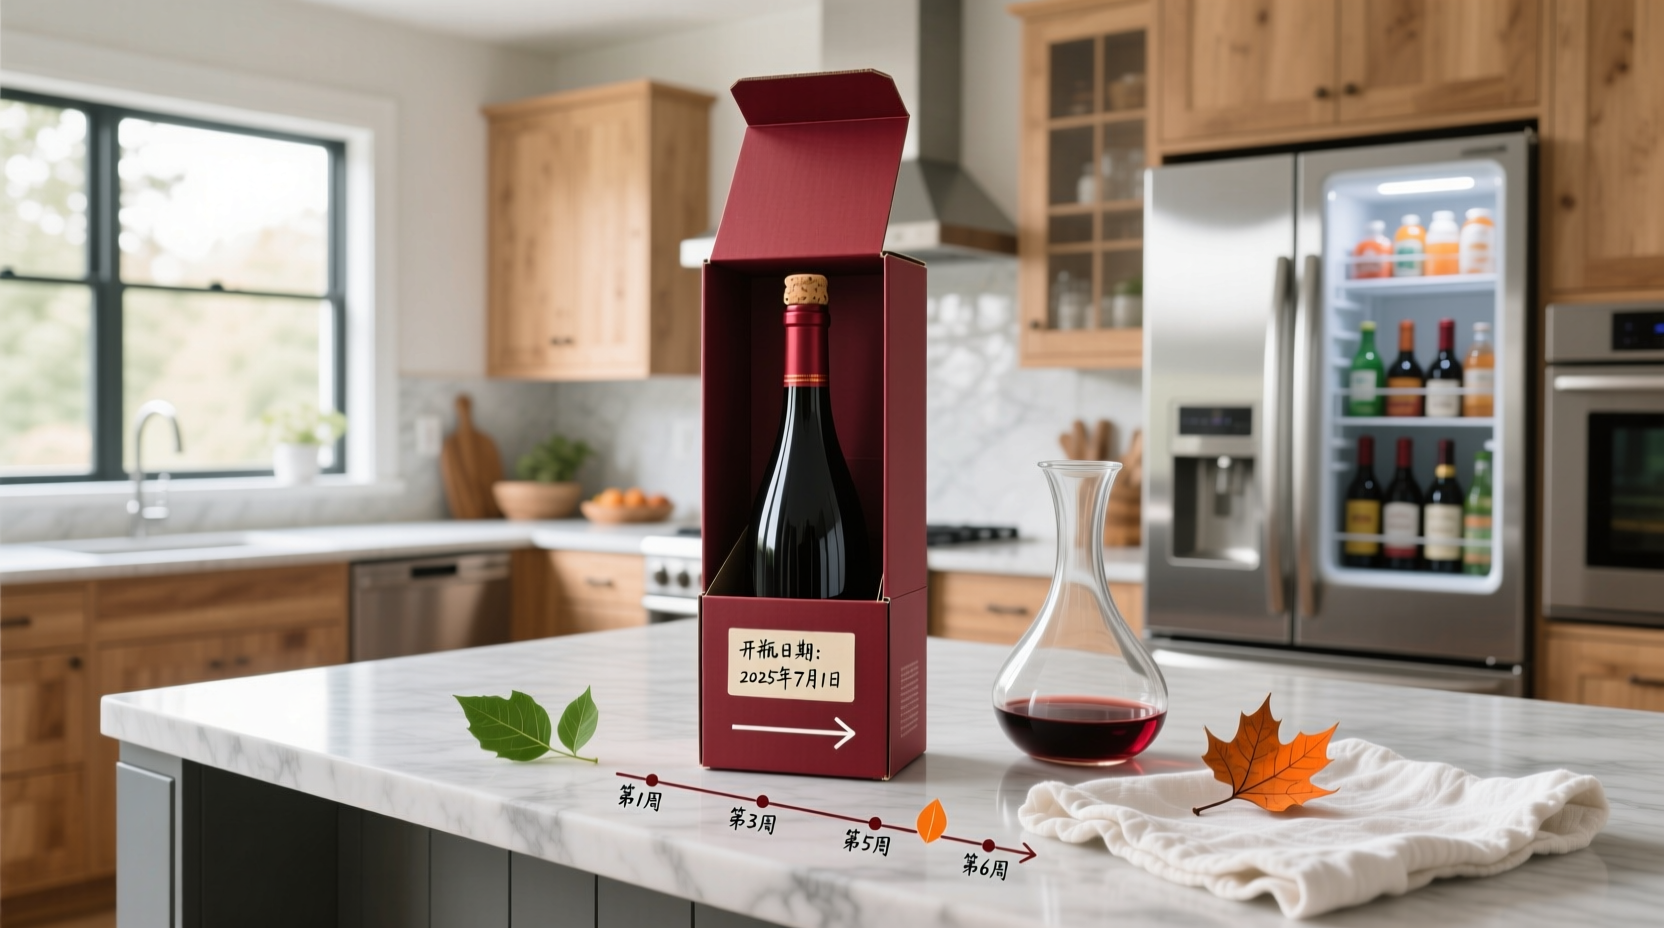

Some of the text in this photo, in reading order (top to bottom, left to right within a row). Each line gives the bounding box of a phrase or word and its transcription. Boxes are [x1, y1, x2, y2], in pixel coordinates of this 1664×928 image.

[739, 666, 840, 690] 2025年7月1日
[618, 783, 663, 812] 第1周
[730, 806, 777, 836] 第3周
[843, 828, 892, 857] 第5周
[962, 852, 1009, 882] 第6周
